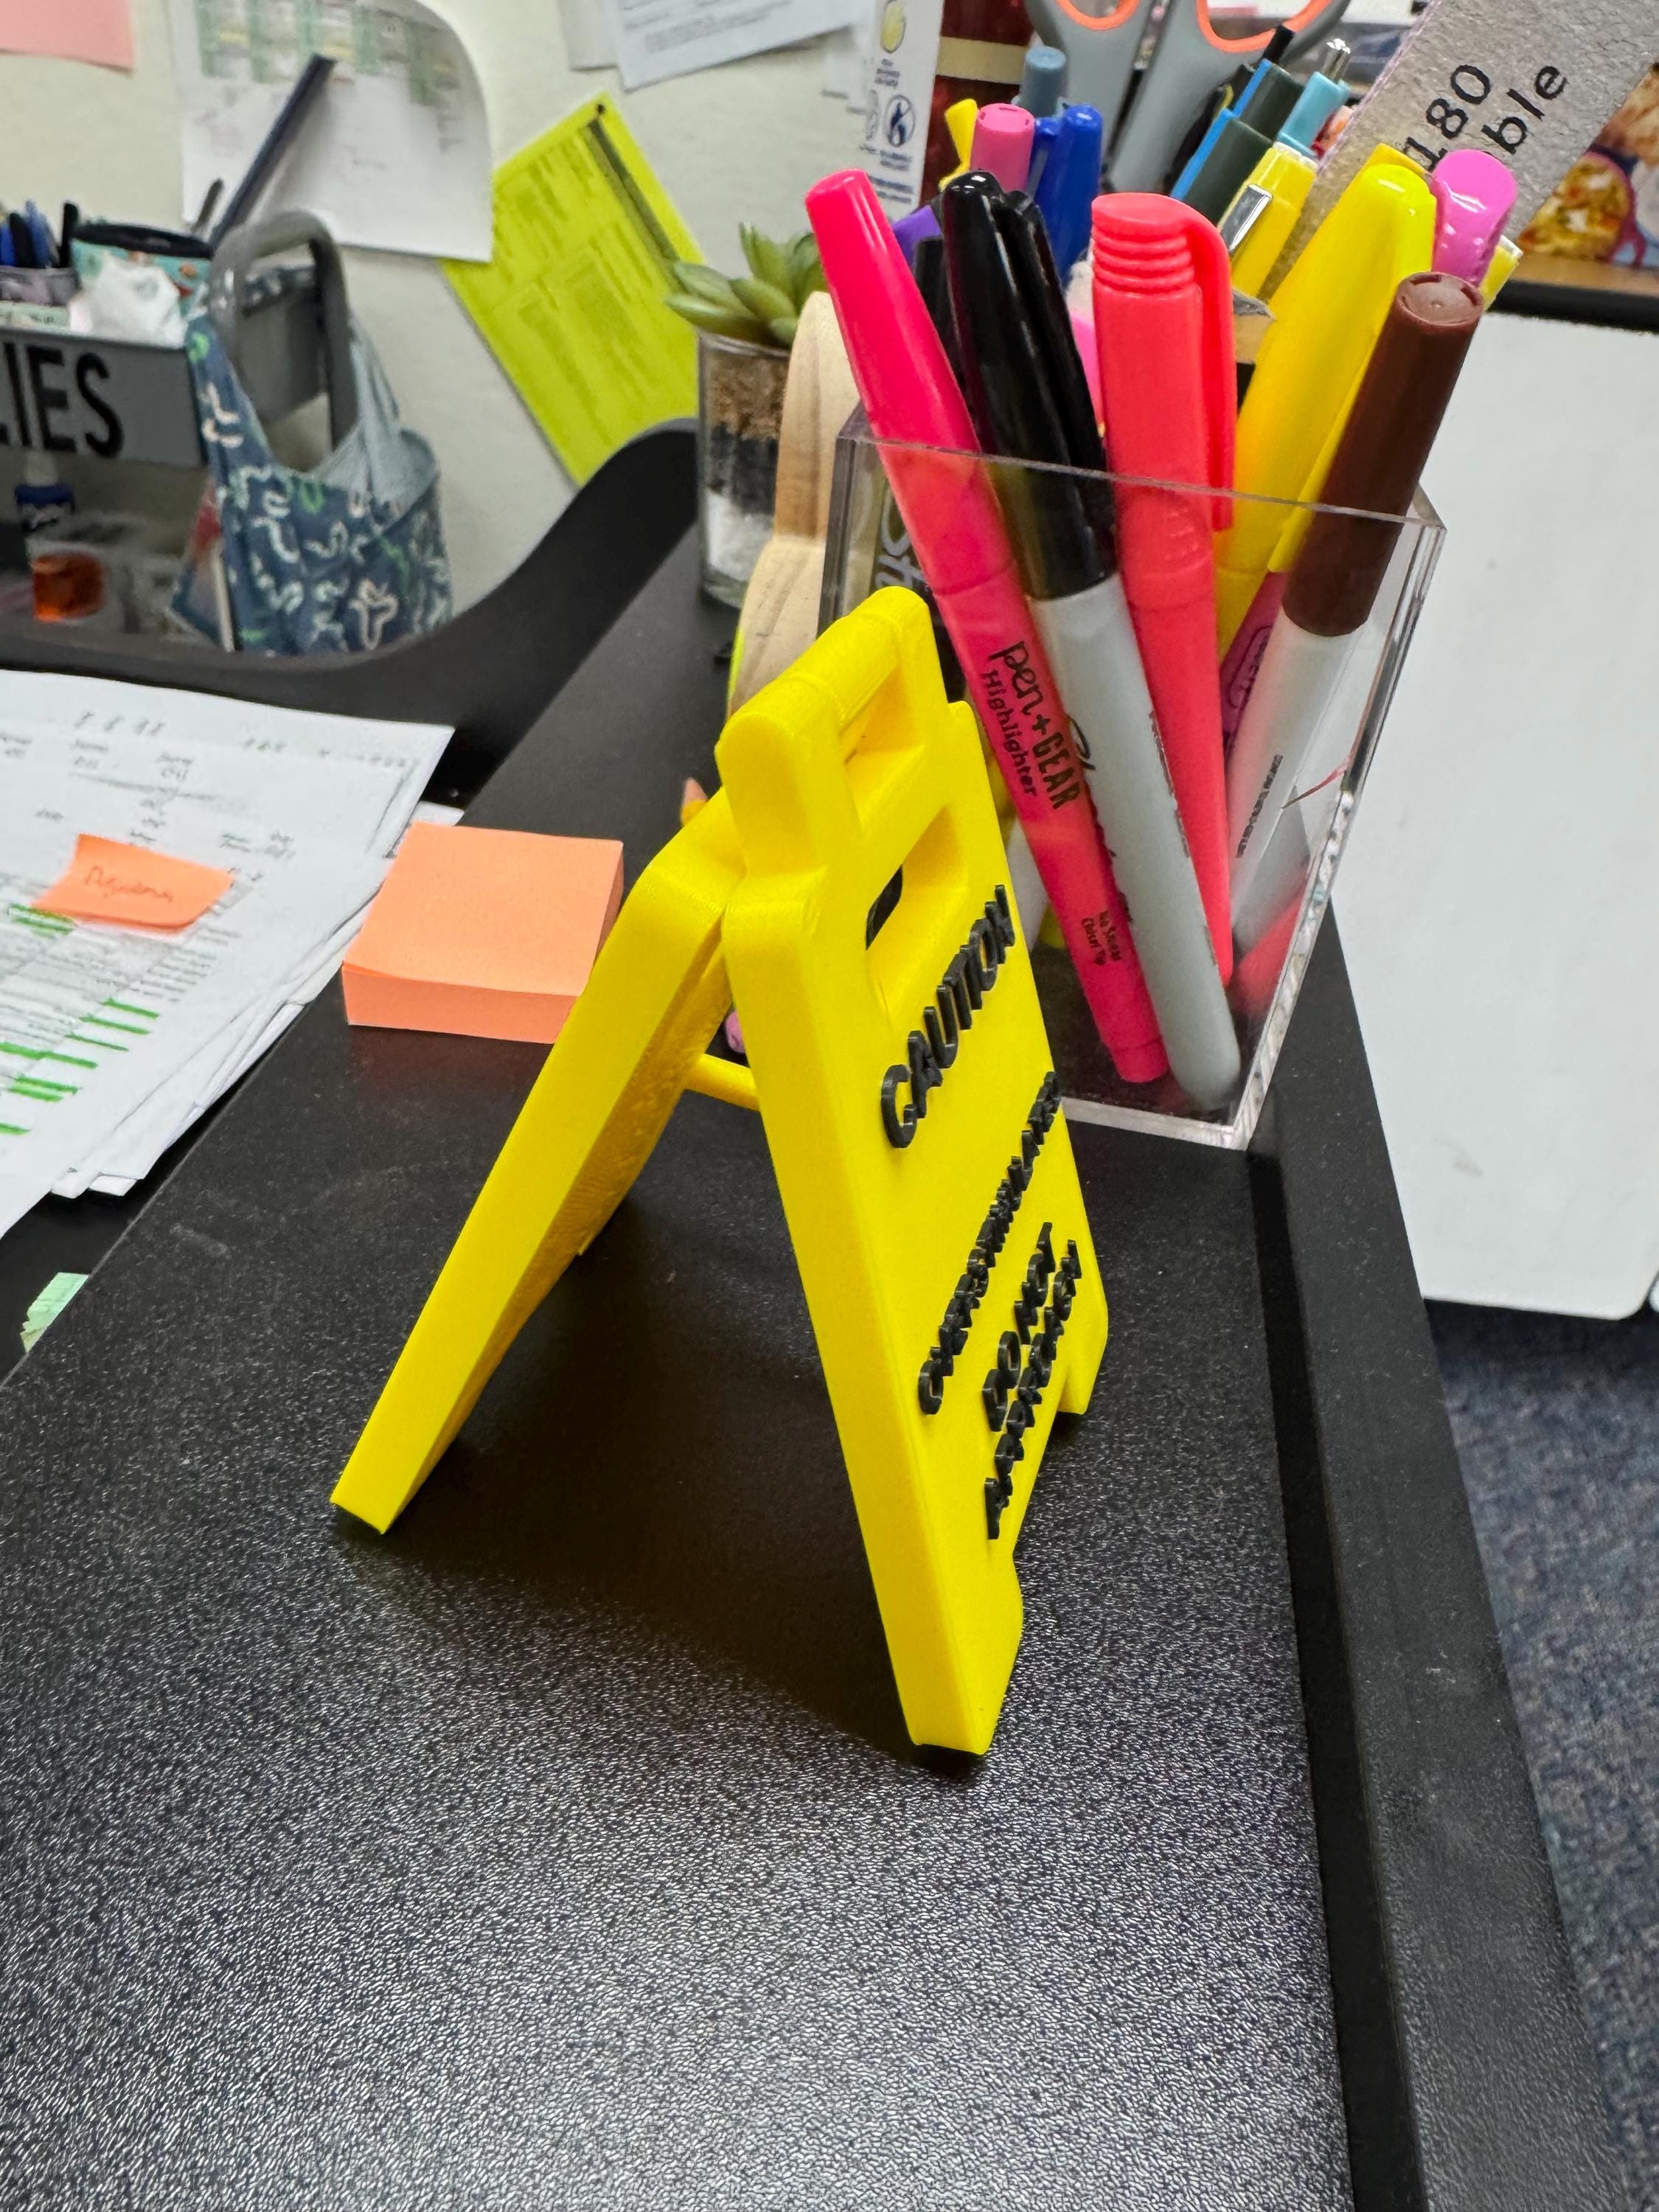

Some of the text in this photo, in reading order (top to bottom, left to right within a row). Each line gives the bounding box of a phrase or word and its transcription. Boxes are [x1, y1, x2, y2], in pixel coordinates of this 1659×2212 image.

[1481, 65, 1570, 161] ble
[980, 669, 1037, 796] Highlighter
[880, 884, 1015, 1149] CAUTION
[982, 1221, 1057, 1433] DO NOT
[984, 1239, 1083, 1541] APPROACH
